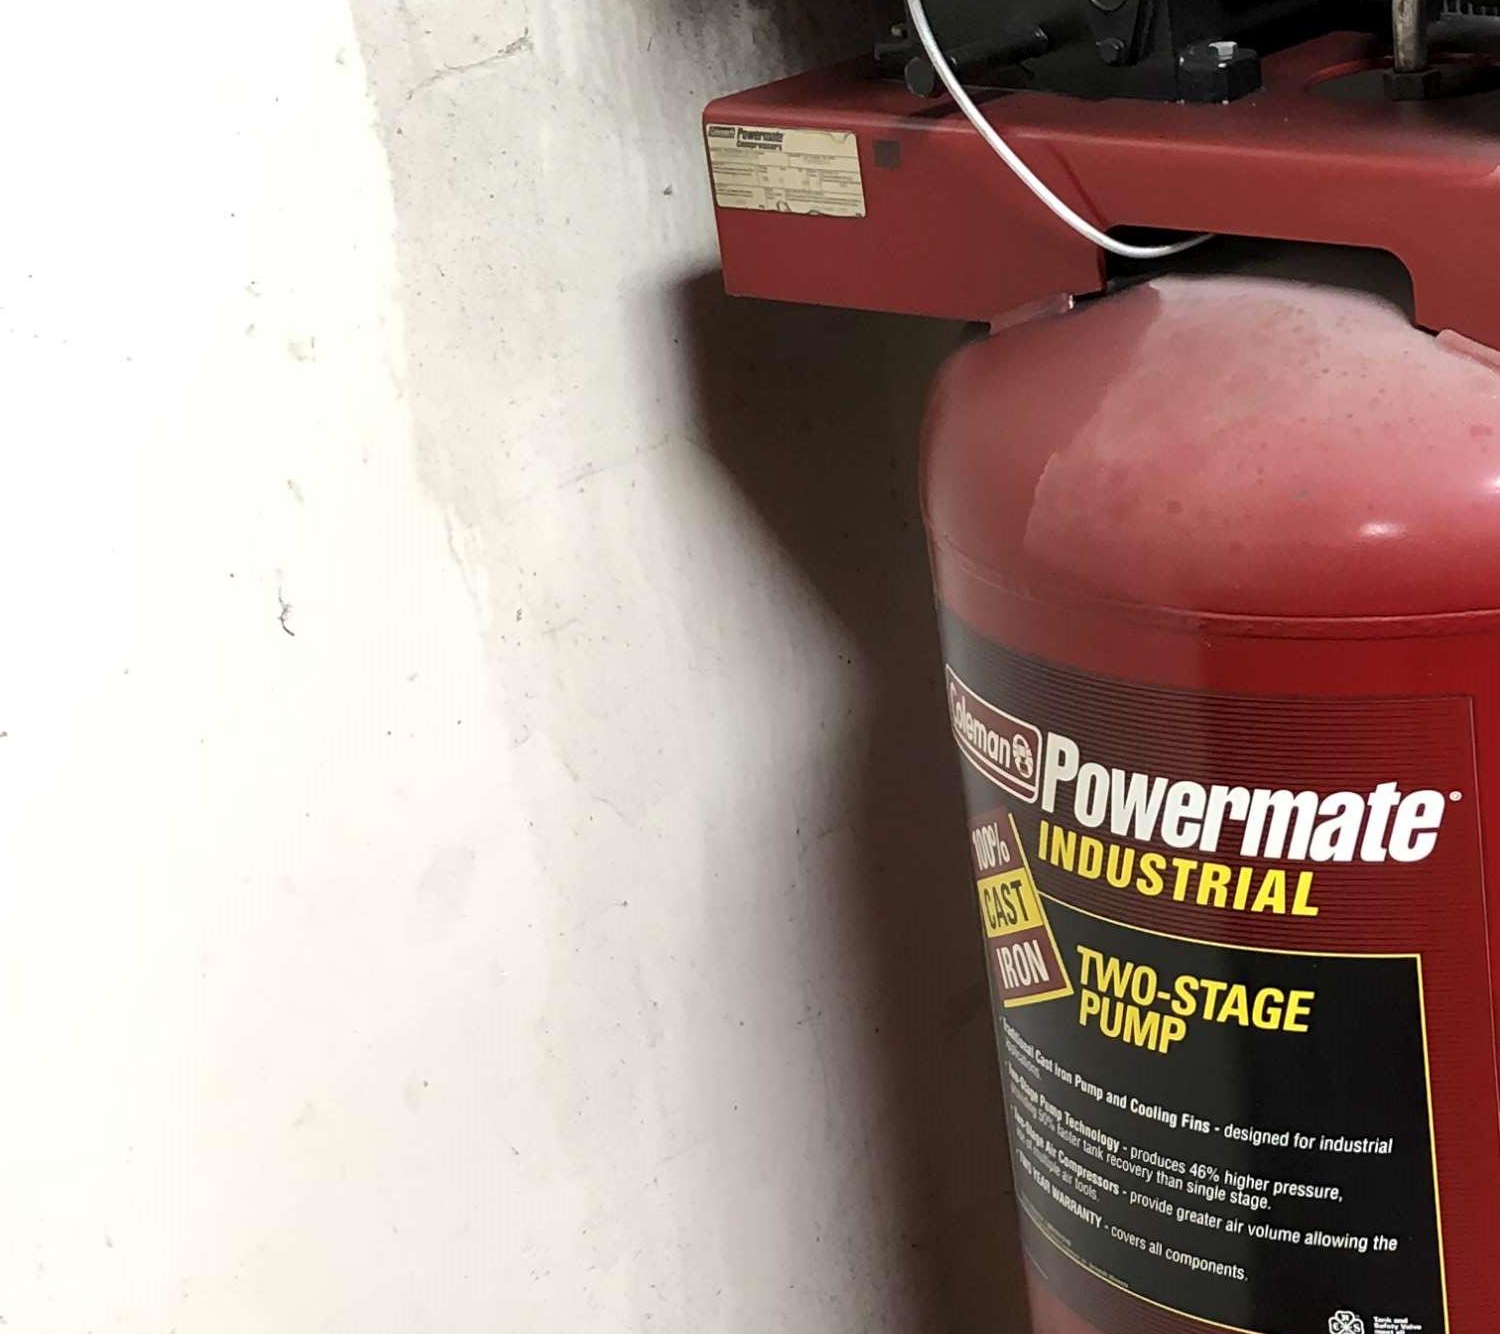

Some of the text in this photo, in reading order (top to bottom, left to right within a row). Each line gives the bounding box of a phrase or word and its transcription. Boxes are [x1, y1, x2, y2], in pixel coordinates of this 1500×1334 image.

[950, 681, 1445, 862] Coleman Powermate
[972, 822, 1010, 871] 100%
[1038, 820, 1319, 916] INDUSTRIAL
[982, 880, 1030, 930] CAST
[996, 939, 1049, 989] IRON
[1077, 945, 1315, 1032] TWO-STAGE
[1079, 988, 1187, 1054] PUMP
[1035, 1049, 1054, 1072] Cast
[1055, 1062, 1072, 1084] Iron
[1074, 1074, 1103, 1101] Pump
[1106, 1091, 1127, 1109] and
[1130, 1098, 1177, 1128] Cooling
[1181, 1113, 1210, 1134] Fins
[1224, 1123, 1289, 1147] designed
[1293, 1132, 1316, 1149] for
[1319, 1135, 1394, 1154] industrial
[1040, 1094, 1062, 1121] Pump
[1064, 1111, 1120, 1153] Technology
[1131, 1146, 1186, 1175] produces
[1189, 1162, 1220, 1183] 46%
[1224, 1169, 1270, 1192] higher
[1273, 1181, 1343, 1202] pressure,
[1057, 1123, 1081, 1147] faster
[1083, 1140, 1104, 1161] tank
[1106, 1152, 1153, 1183] recovery
[1156, 1170, 1183, 1190] than
[1187, 1181, 1226, 1201] single
[1230, 1191, 1271, 1211] stage.
[1033, 1167, 1050, 1194] YEAR
[1052, 1185, 1102, 1228] WARRANTY
[1111, 1225, 1146, 1250] covers
[1149, 1241, 1162, 1256] all
[1165, 1248, 1248, 1281] components.
[1045, 1140, 1058, 1159] Air
[1058, 1150, 1120, 1195] Compressors
[1130, 1191, 1173, 1216] provide
[1177, 1207, 1223, 1229] greater
[1225, 1219, 1244, 1233] air
[1248, 1224, 1300, 1243] volume
[1304, 1230, 1368, 1253] allowing
[1373, 1234, 1398, 1251] the
